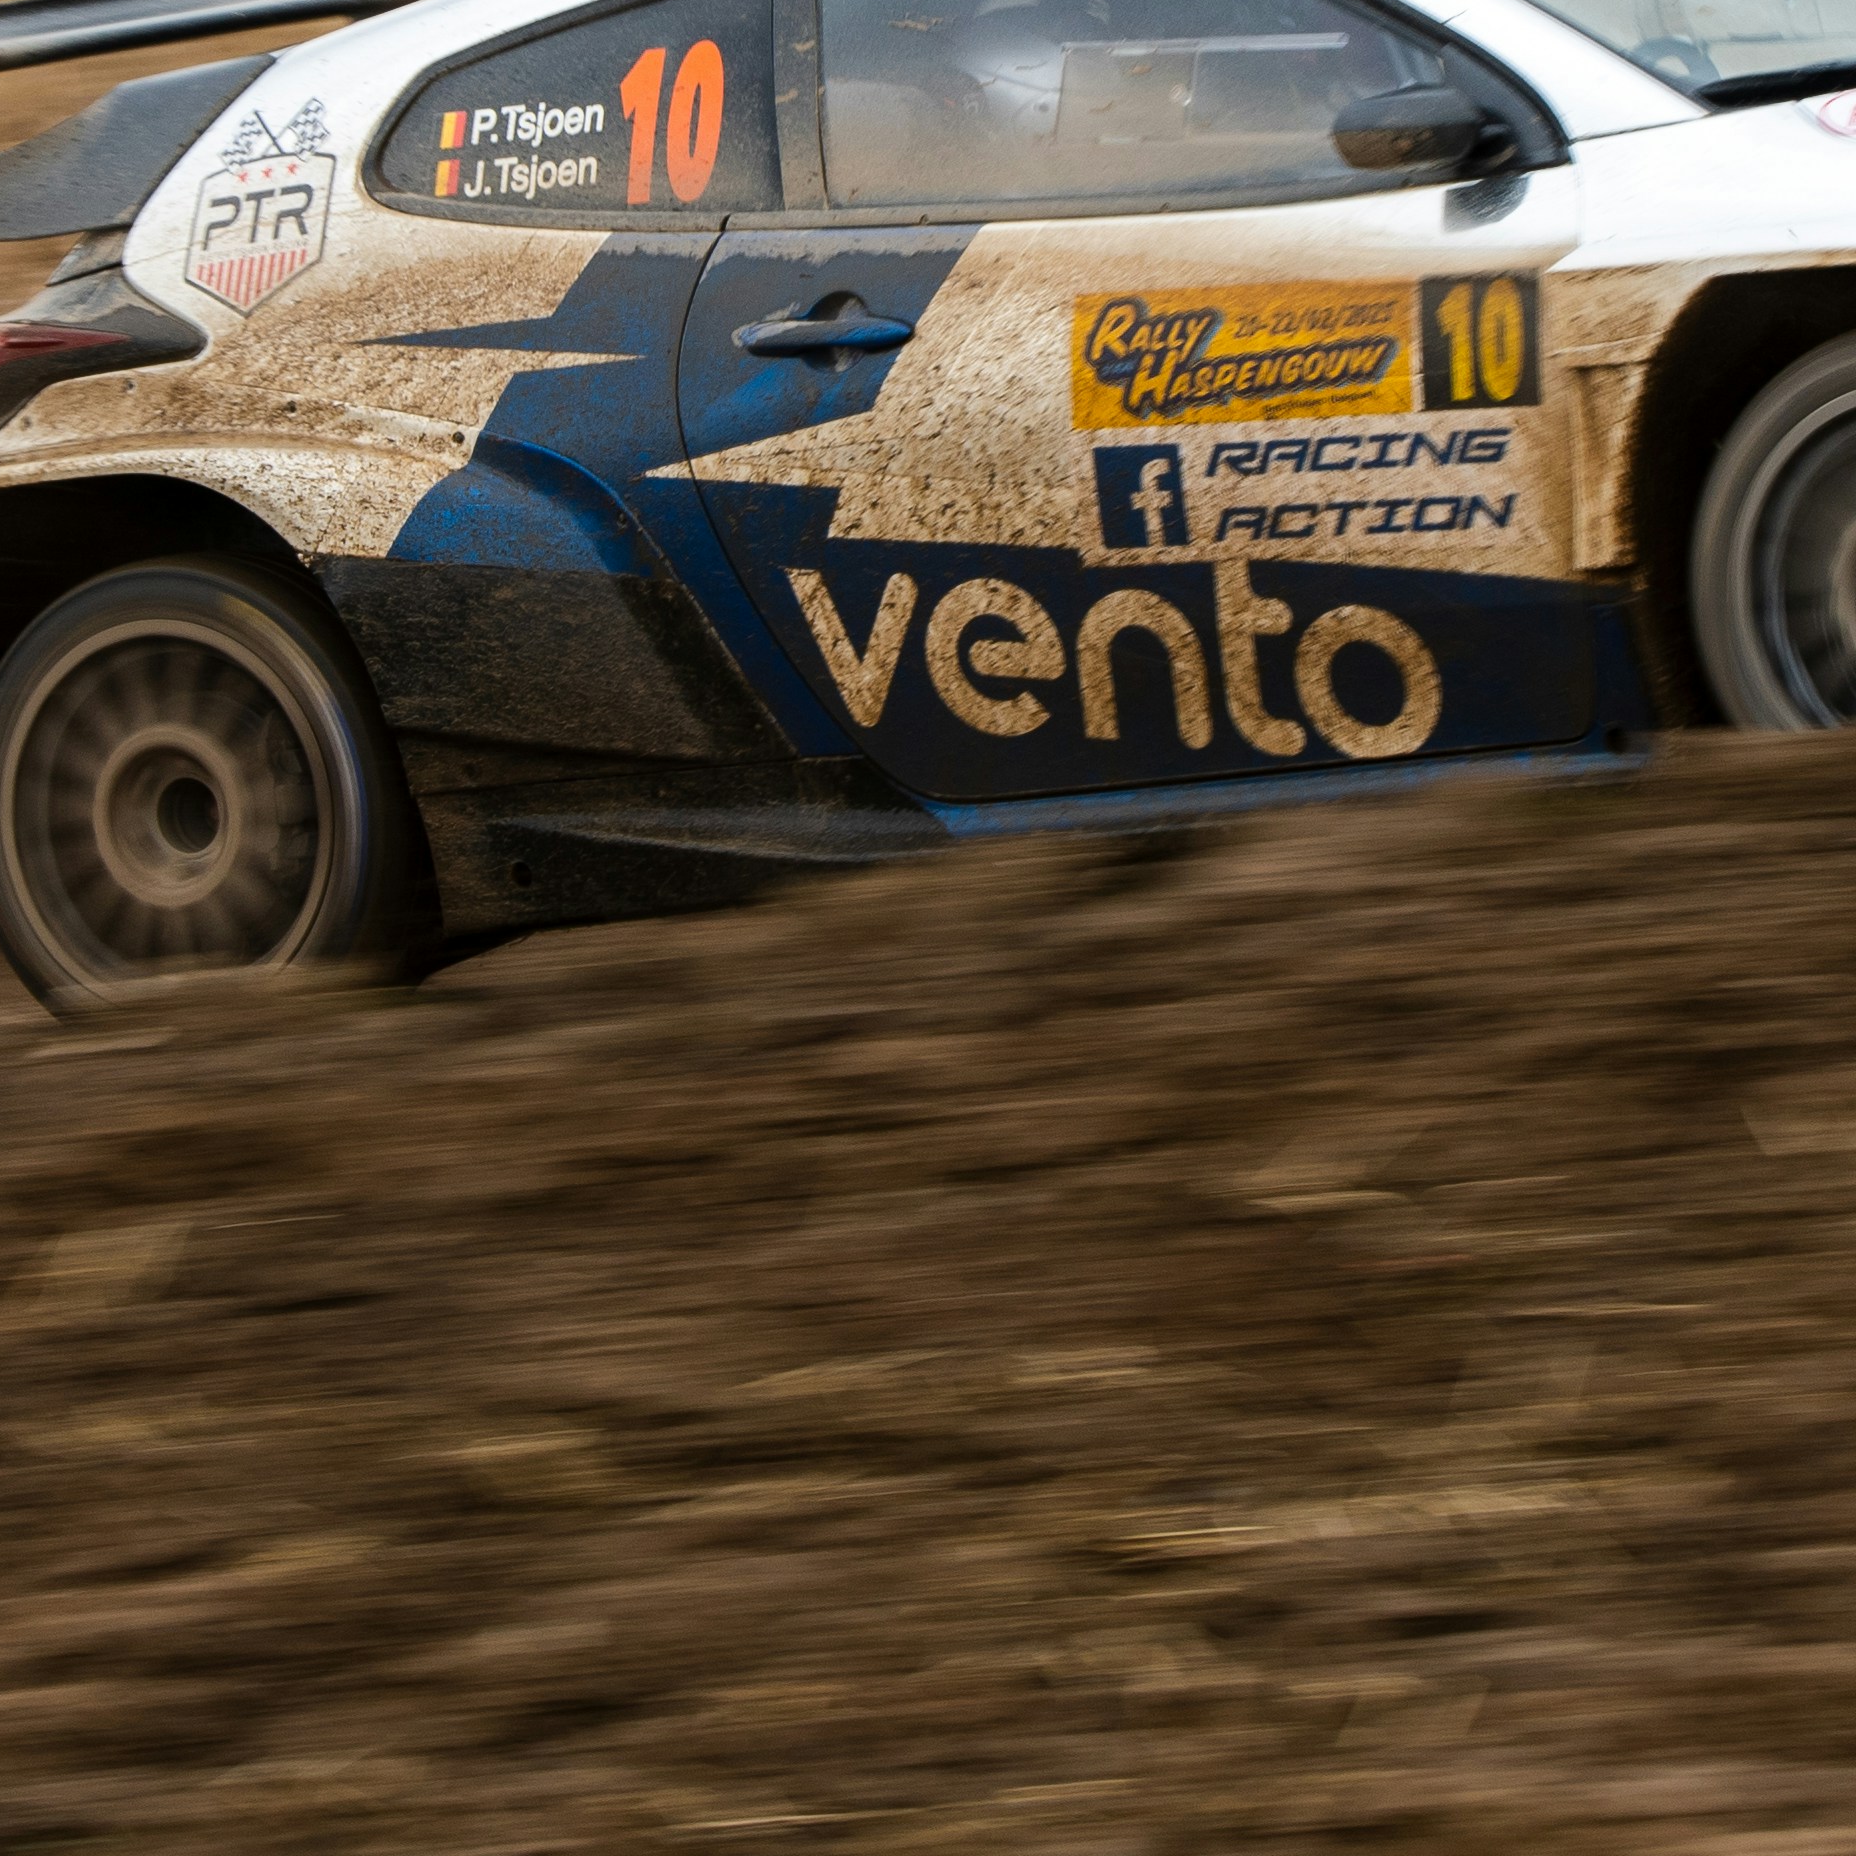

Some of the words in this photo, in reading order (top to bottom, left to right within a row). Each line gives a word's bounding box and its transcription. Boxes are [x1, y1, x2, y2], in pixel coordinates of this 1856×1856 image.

[619, 38, 725, 205] 10
[201, 183, 314, 251] PTR
[1434, 276, 1525, 403] 10
[1206, 427, 1512, 478] RACING
[1214, 492, 1521, 542] ACTION
[784, 559, 1442, 760] vento
